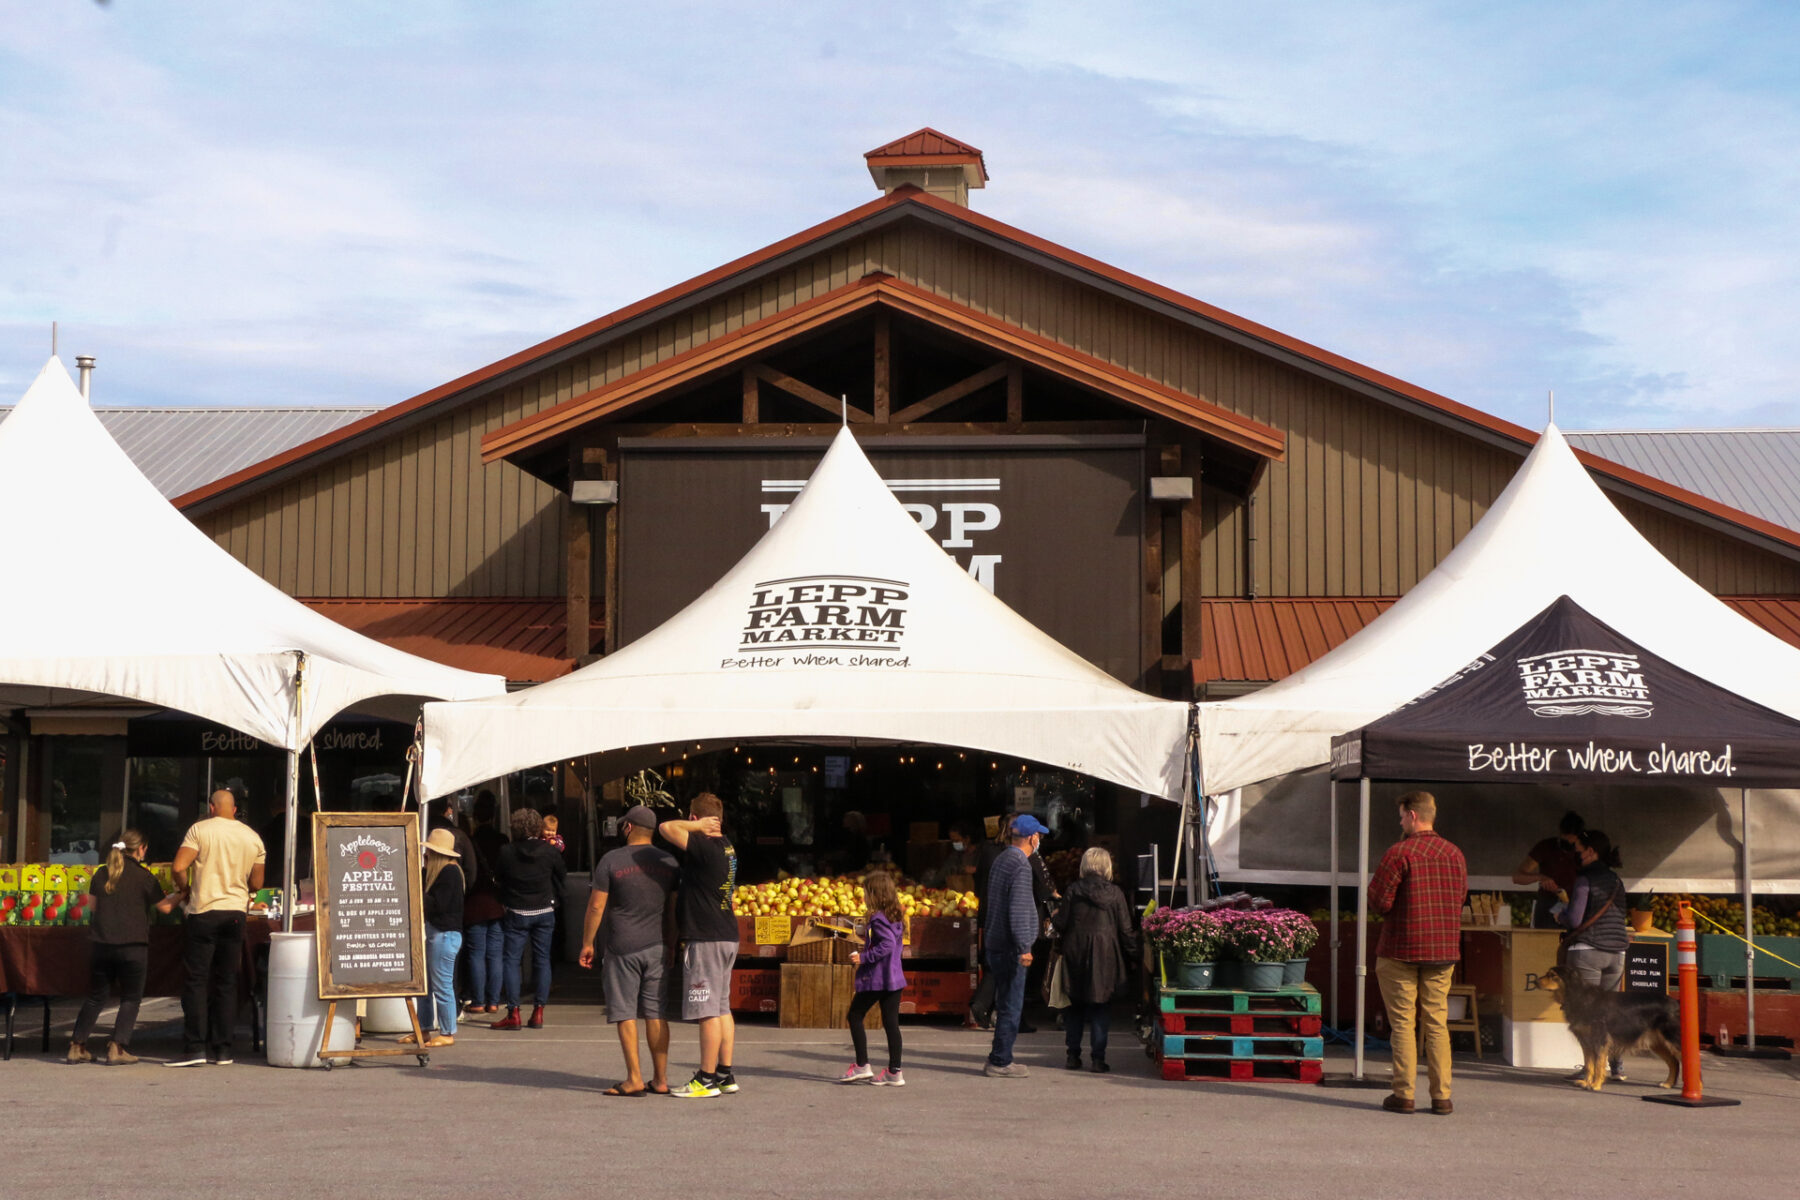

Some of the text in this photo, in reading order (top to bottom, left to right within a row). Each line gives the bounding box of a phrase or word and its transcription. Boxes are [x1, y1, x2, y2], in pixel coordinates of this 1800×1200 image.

[749, 584, 909, 609] LEPP
[744, 604, 907, 630] FARM
[739, 627, 904, 645] MARKET
[720, 653, 911, 669] Better when shared.
[1518, 655, 1641, 677] LEPP
[1520, 669, 1648, 690] FARM
[1523, 684, 1650, 700] MARKET
[1468, 741, 1737, 777] Better when shared.
[342, 870, 393, 882] APPLE
[342, 882, 396, 892] FESTIVAL
